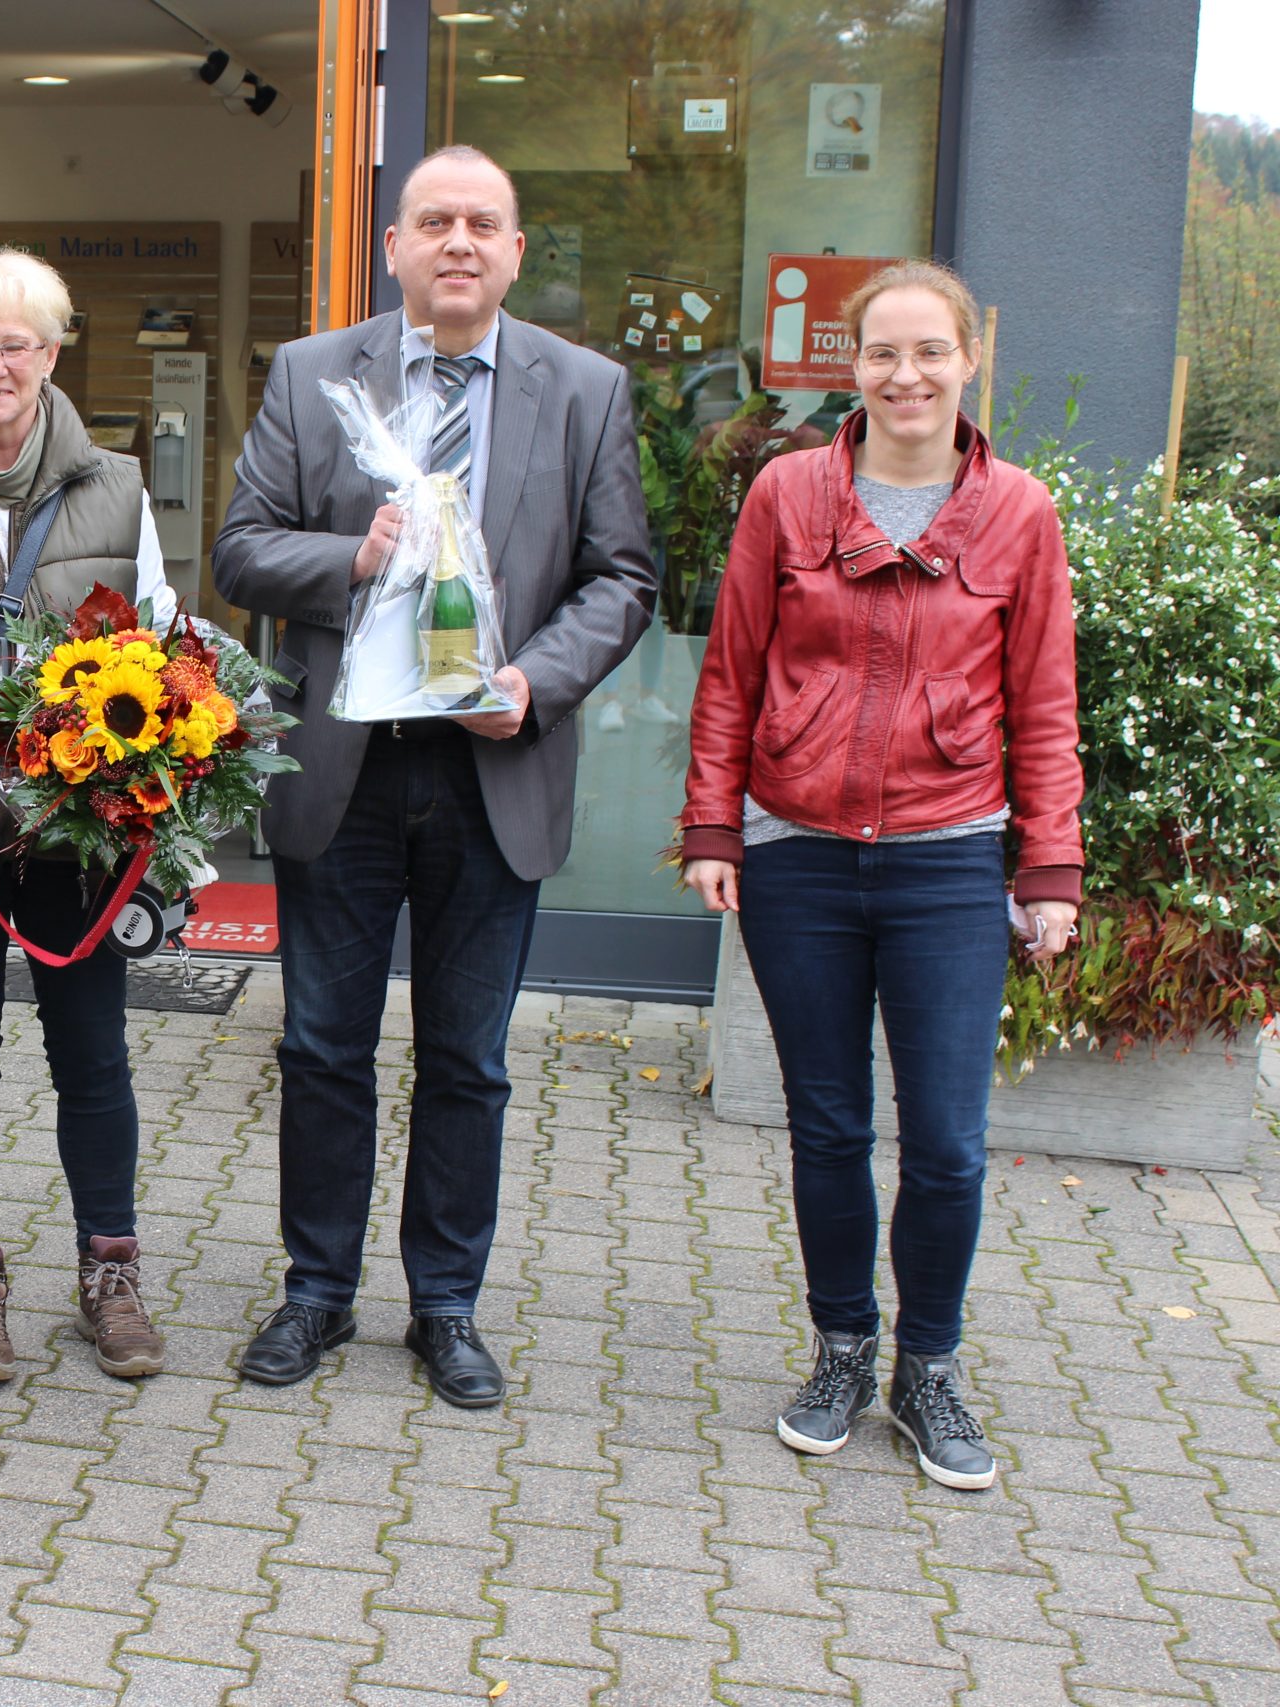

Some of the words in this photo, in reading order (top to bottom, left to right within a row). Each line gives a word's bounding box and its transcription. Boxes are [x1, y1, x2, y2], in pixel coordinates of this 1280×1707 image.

[60, 237, 123, 257] Maria
[134, 236, 198, 257] Laach
[165, 358, 192, 368] Hände
[156, 374, 195, 384] desinfiziert
[126, 911, 142, 936] KONG
